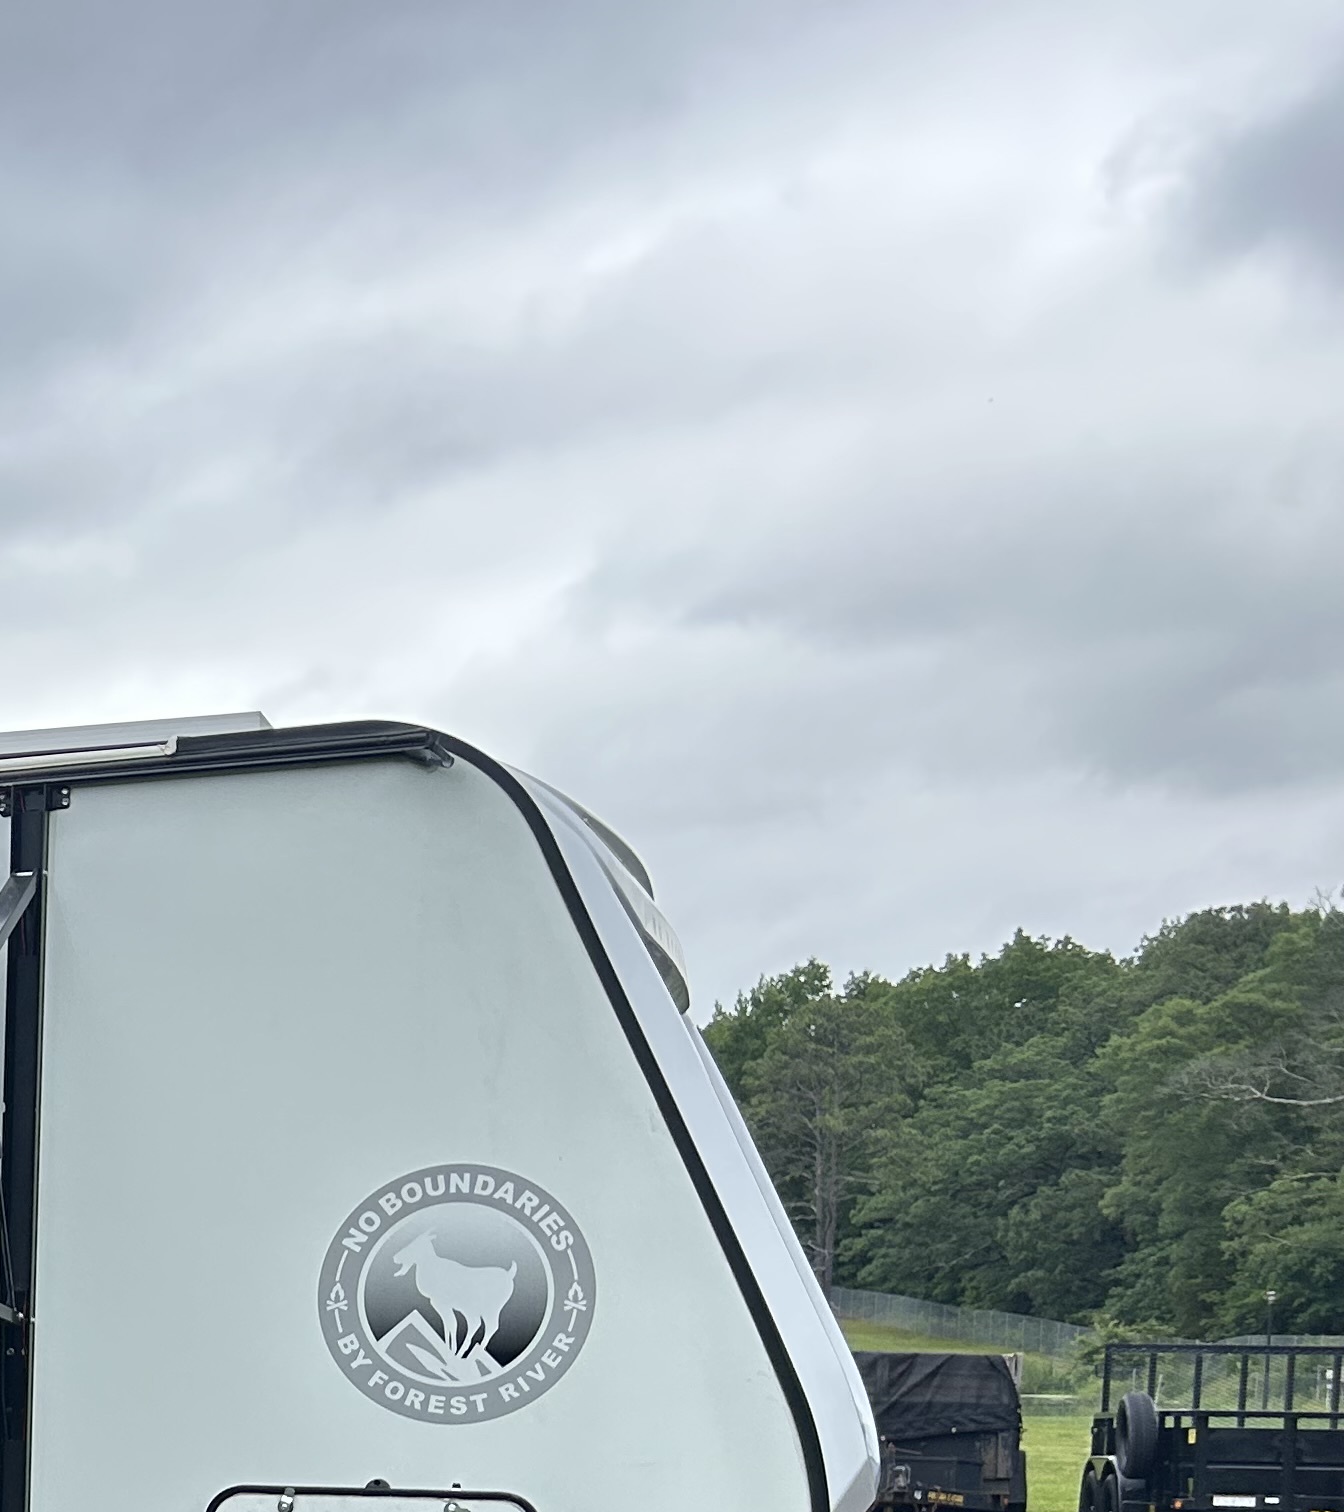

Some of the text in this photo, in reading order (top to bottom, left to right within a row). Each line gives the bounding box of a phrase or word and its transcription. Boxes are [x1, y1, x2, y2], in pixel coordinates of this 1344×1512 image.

[342, 1172, 574, 1253] NO BOUNDARIES
[337, 1332, 575, 1416] BY FOREST RIVER
